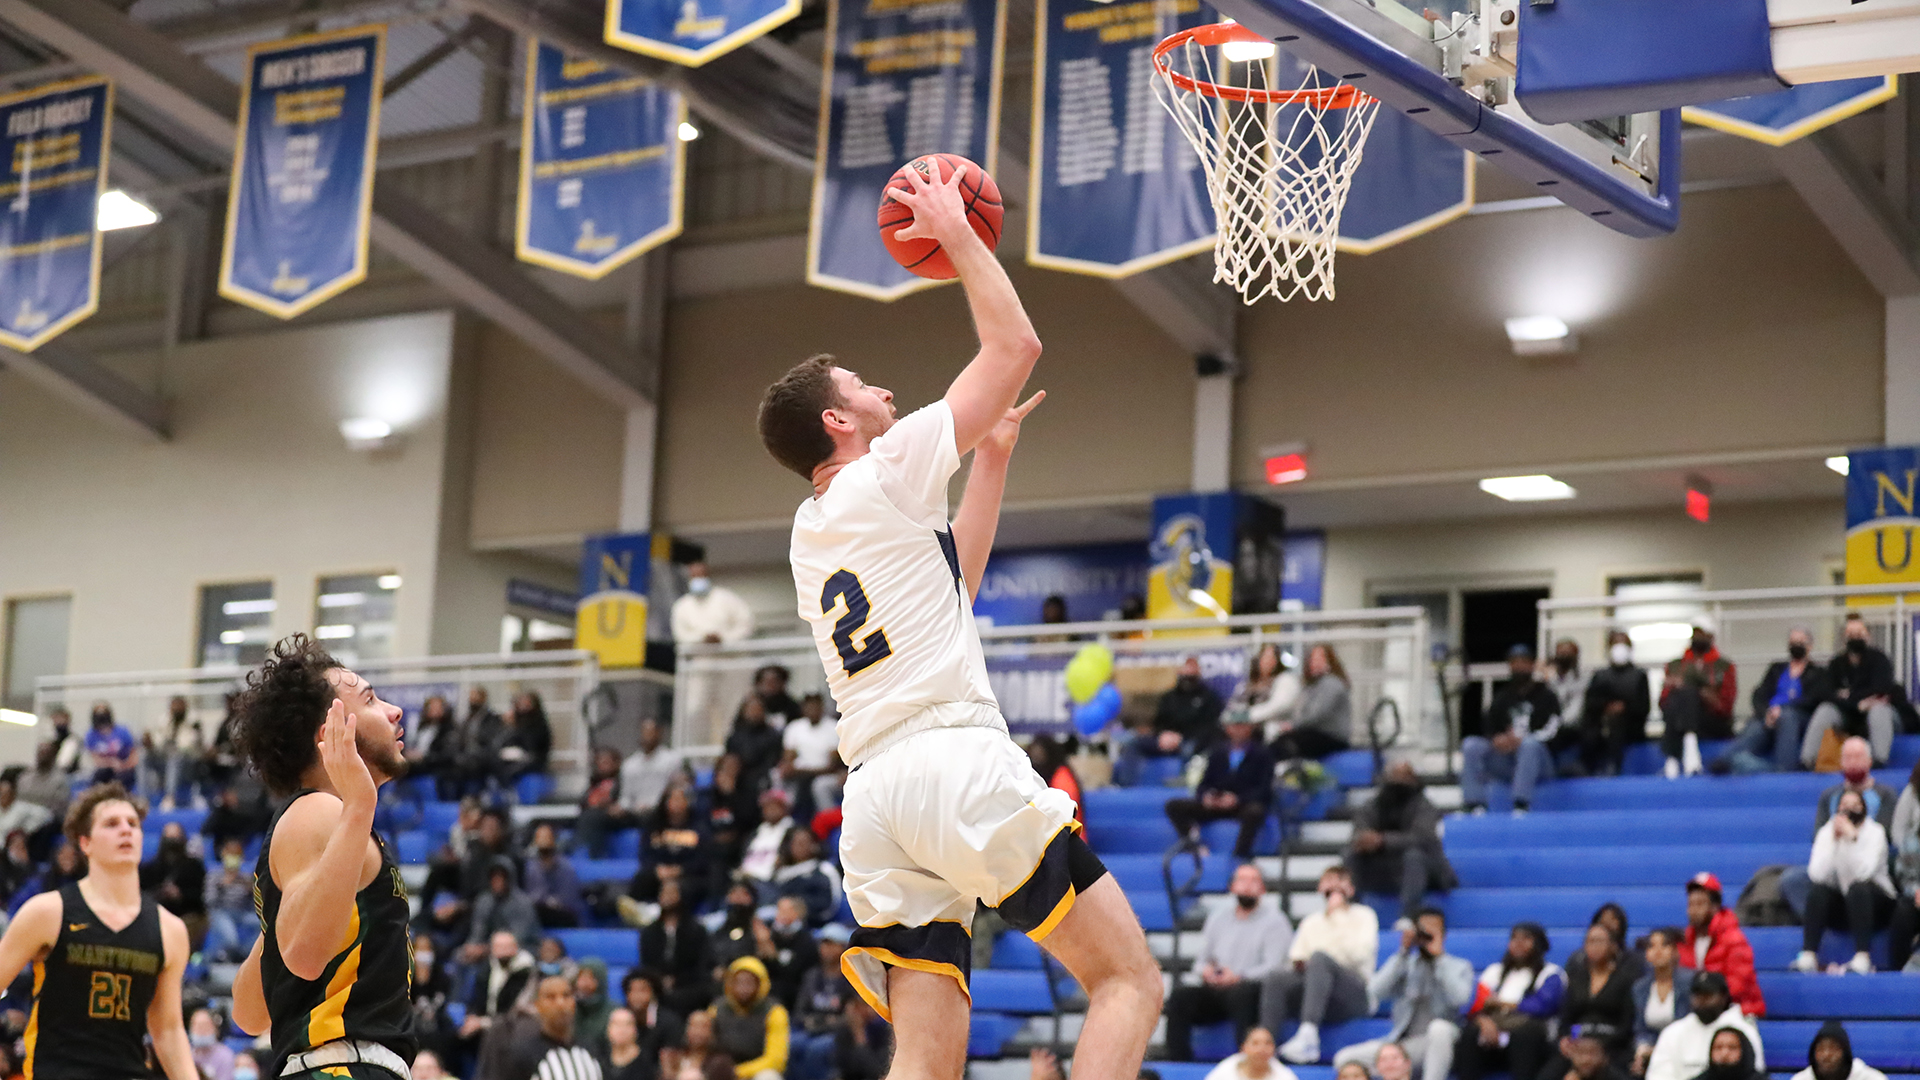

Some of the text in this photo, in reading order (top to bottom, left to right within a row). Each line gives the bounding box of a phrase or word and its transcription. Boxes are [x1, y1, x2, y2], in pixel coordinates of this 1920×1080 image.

[6, 96, 94, 137] FIELD HOCKEY
[1875, 470, 1917, 516] N
[598, 551, 633, 590] N
[1875, 528, 1913, 574] U
[597, 600, 628, 640] U
[820, 566, 895, 680] 2
[66, 942, 159, 976] MARYWOOD
[88, 970, 133, 1021] 21
